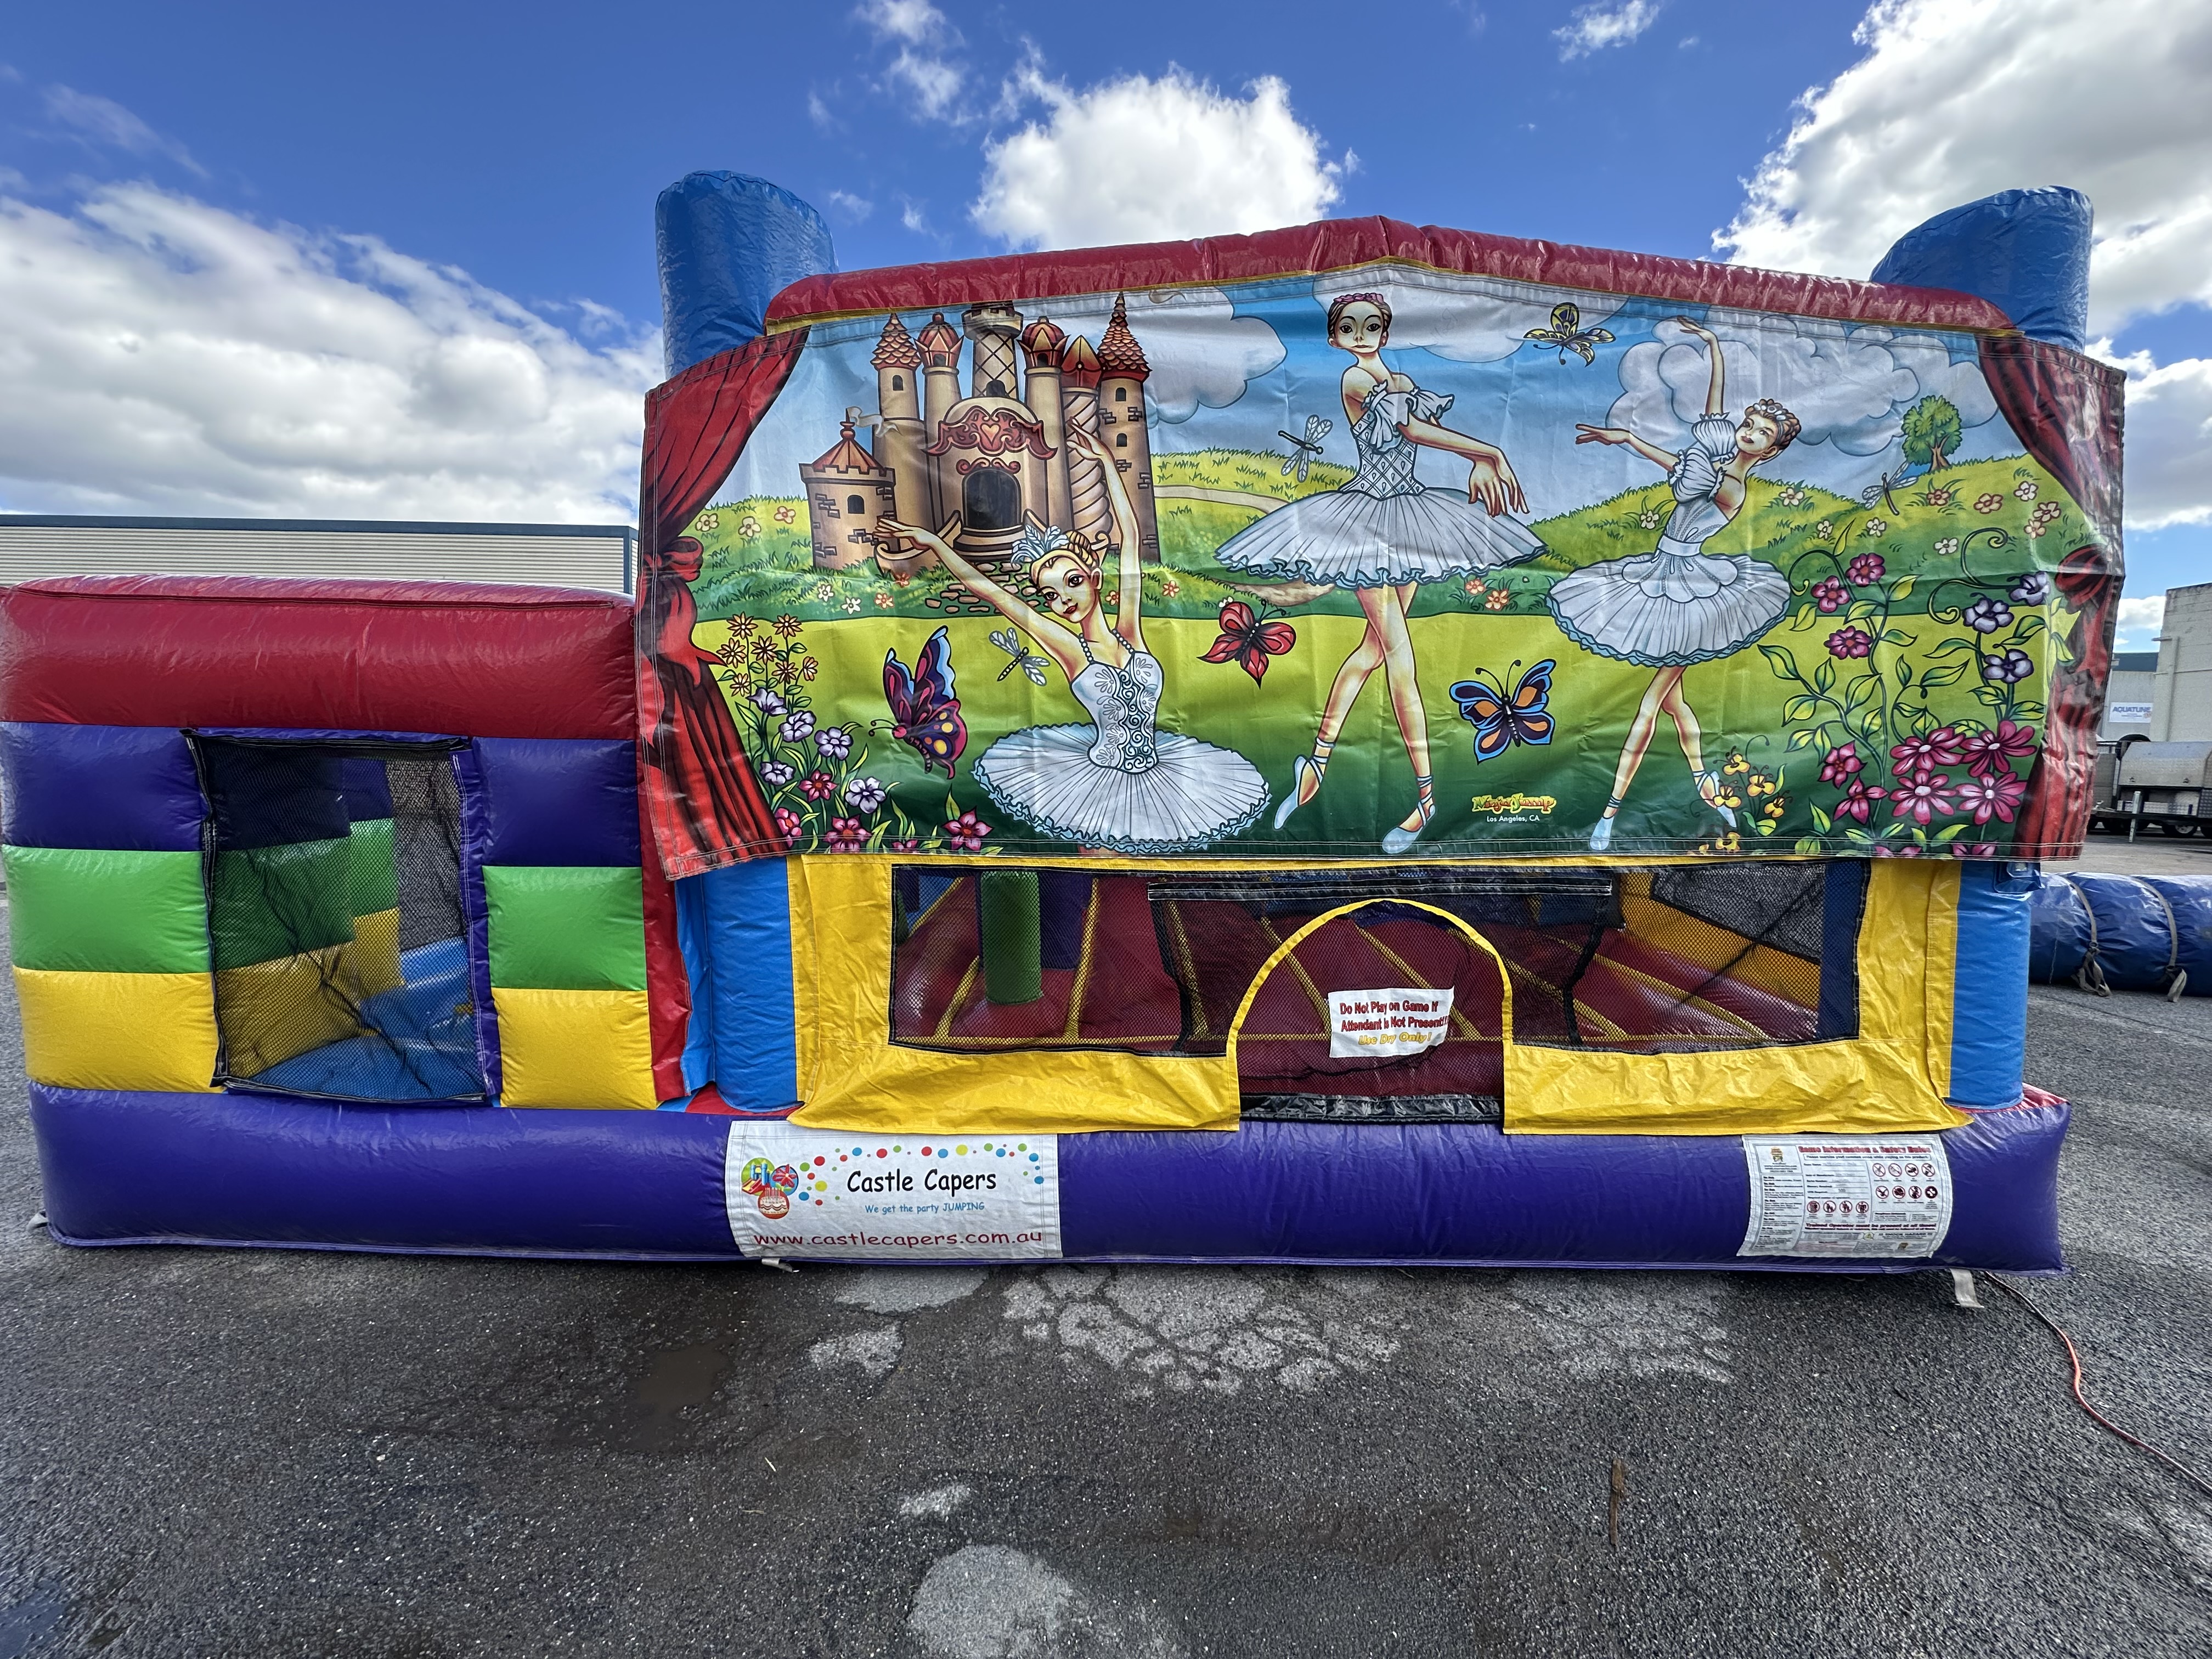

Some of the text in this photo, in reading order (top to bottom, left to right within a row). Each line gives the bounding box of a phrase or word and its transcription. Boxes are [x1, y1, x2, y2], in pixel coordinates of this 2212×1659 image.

[1472, 793, 1556, 814] NinjaJump
[1340, 1000, 1438, 1015] Do Not Play on Game If
[1341, 1019, 1382, 1032] Attendant
[1391, 1016, 1406, 1028] Not
[1358, 1035, 1377, 1045] Use
[1380, 1034, 1396, 1044] Dry
[847, 1169, 997, 1197] Castle Capers
[865, 1201, 985, 1215] We get the party JUMPING
[754, 1231, 1042, 1248] www.castlecapers.com.au
